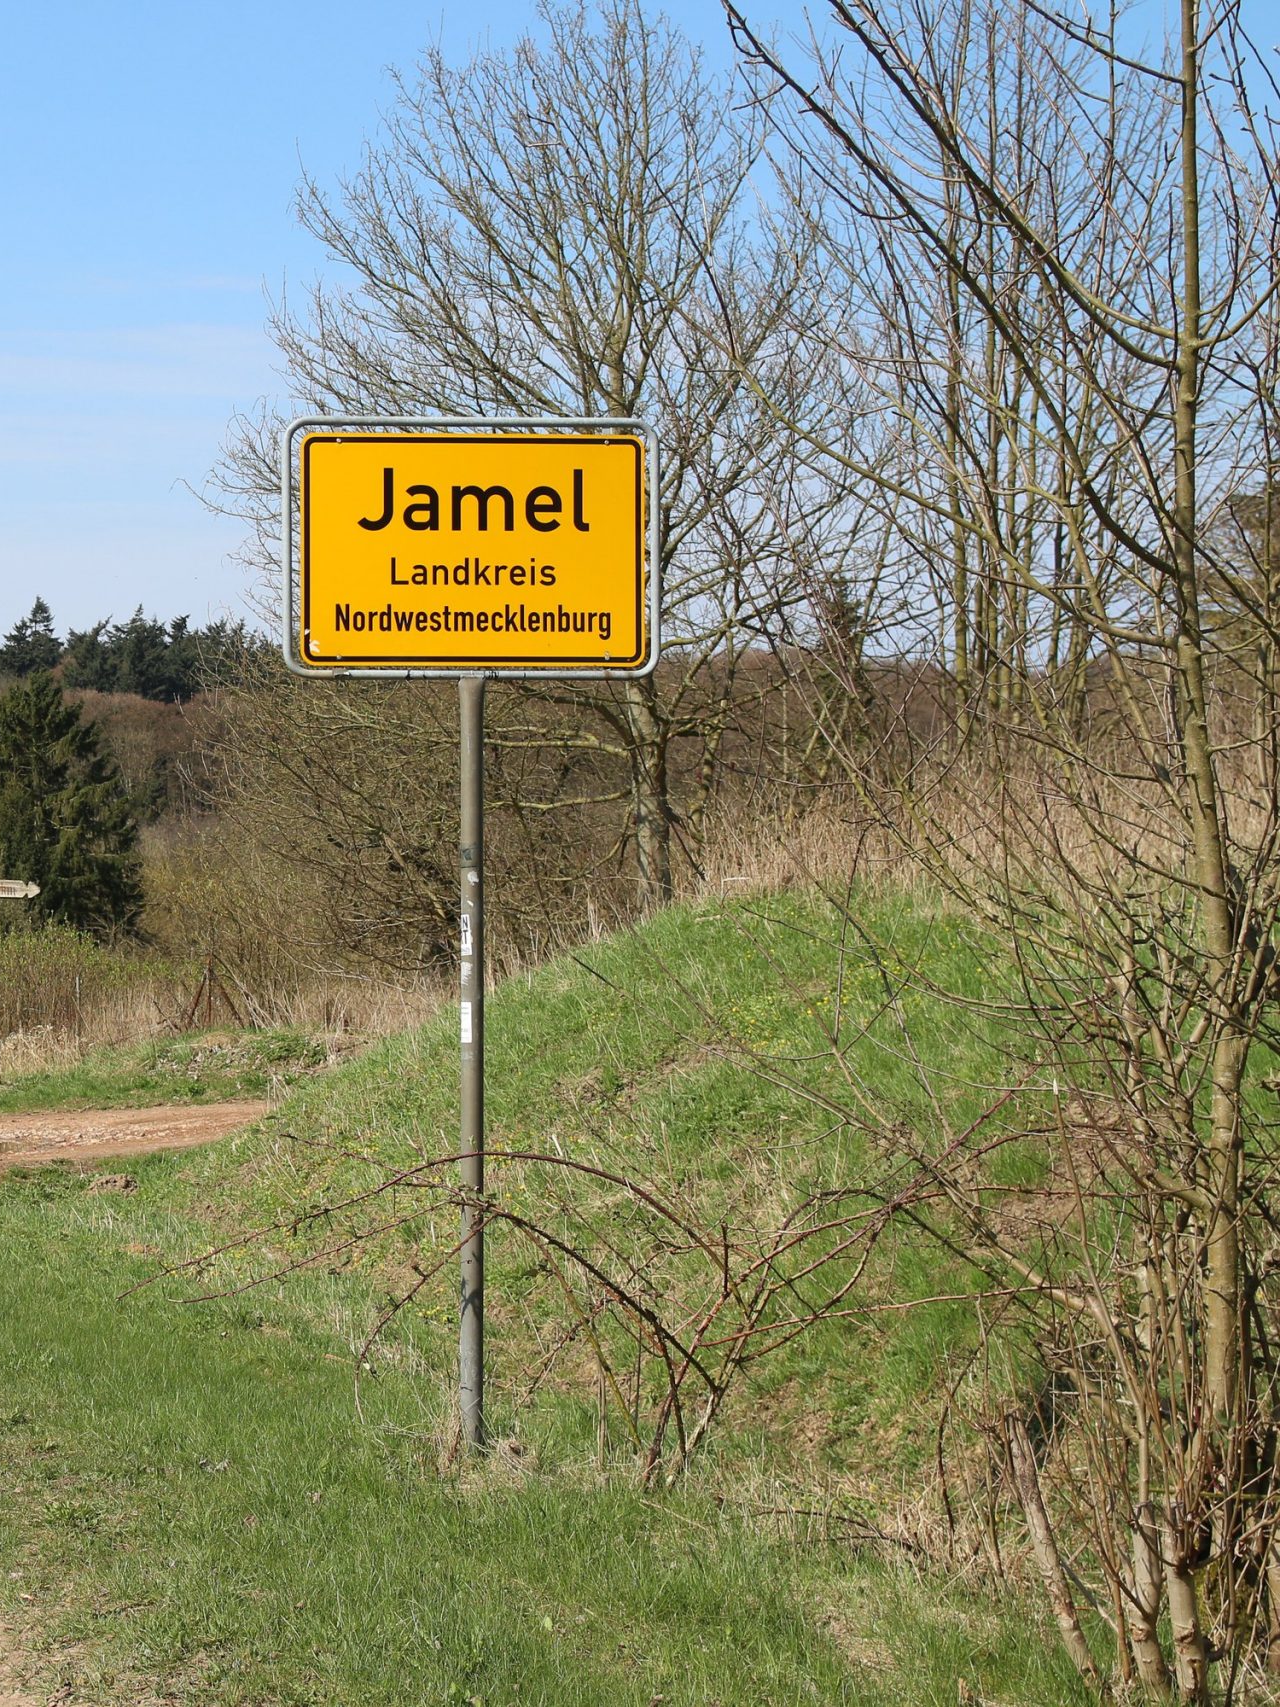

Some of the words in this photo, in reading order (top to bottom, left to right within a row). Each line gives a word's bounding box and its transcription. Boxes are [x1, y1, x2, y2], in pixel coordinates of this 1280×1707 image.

[357, 467, 590, 533] Jamel
[390, 557, 557, 587] Landkreis
[335, 603, 612, 641] Nordwestmecklenburg
